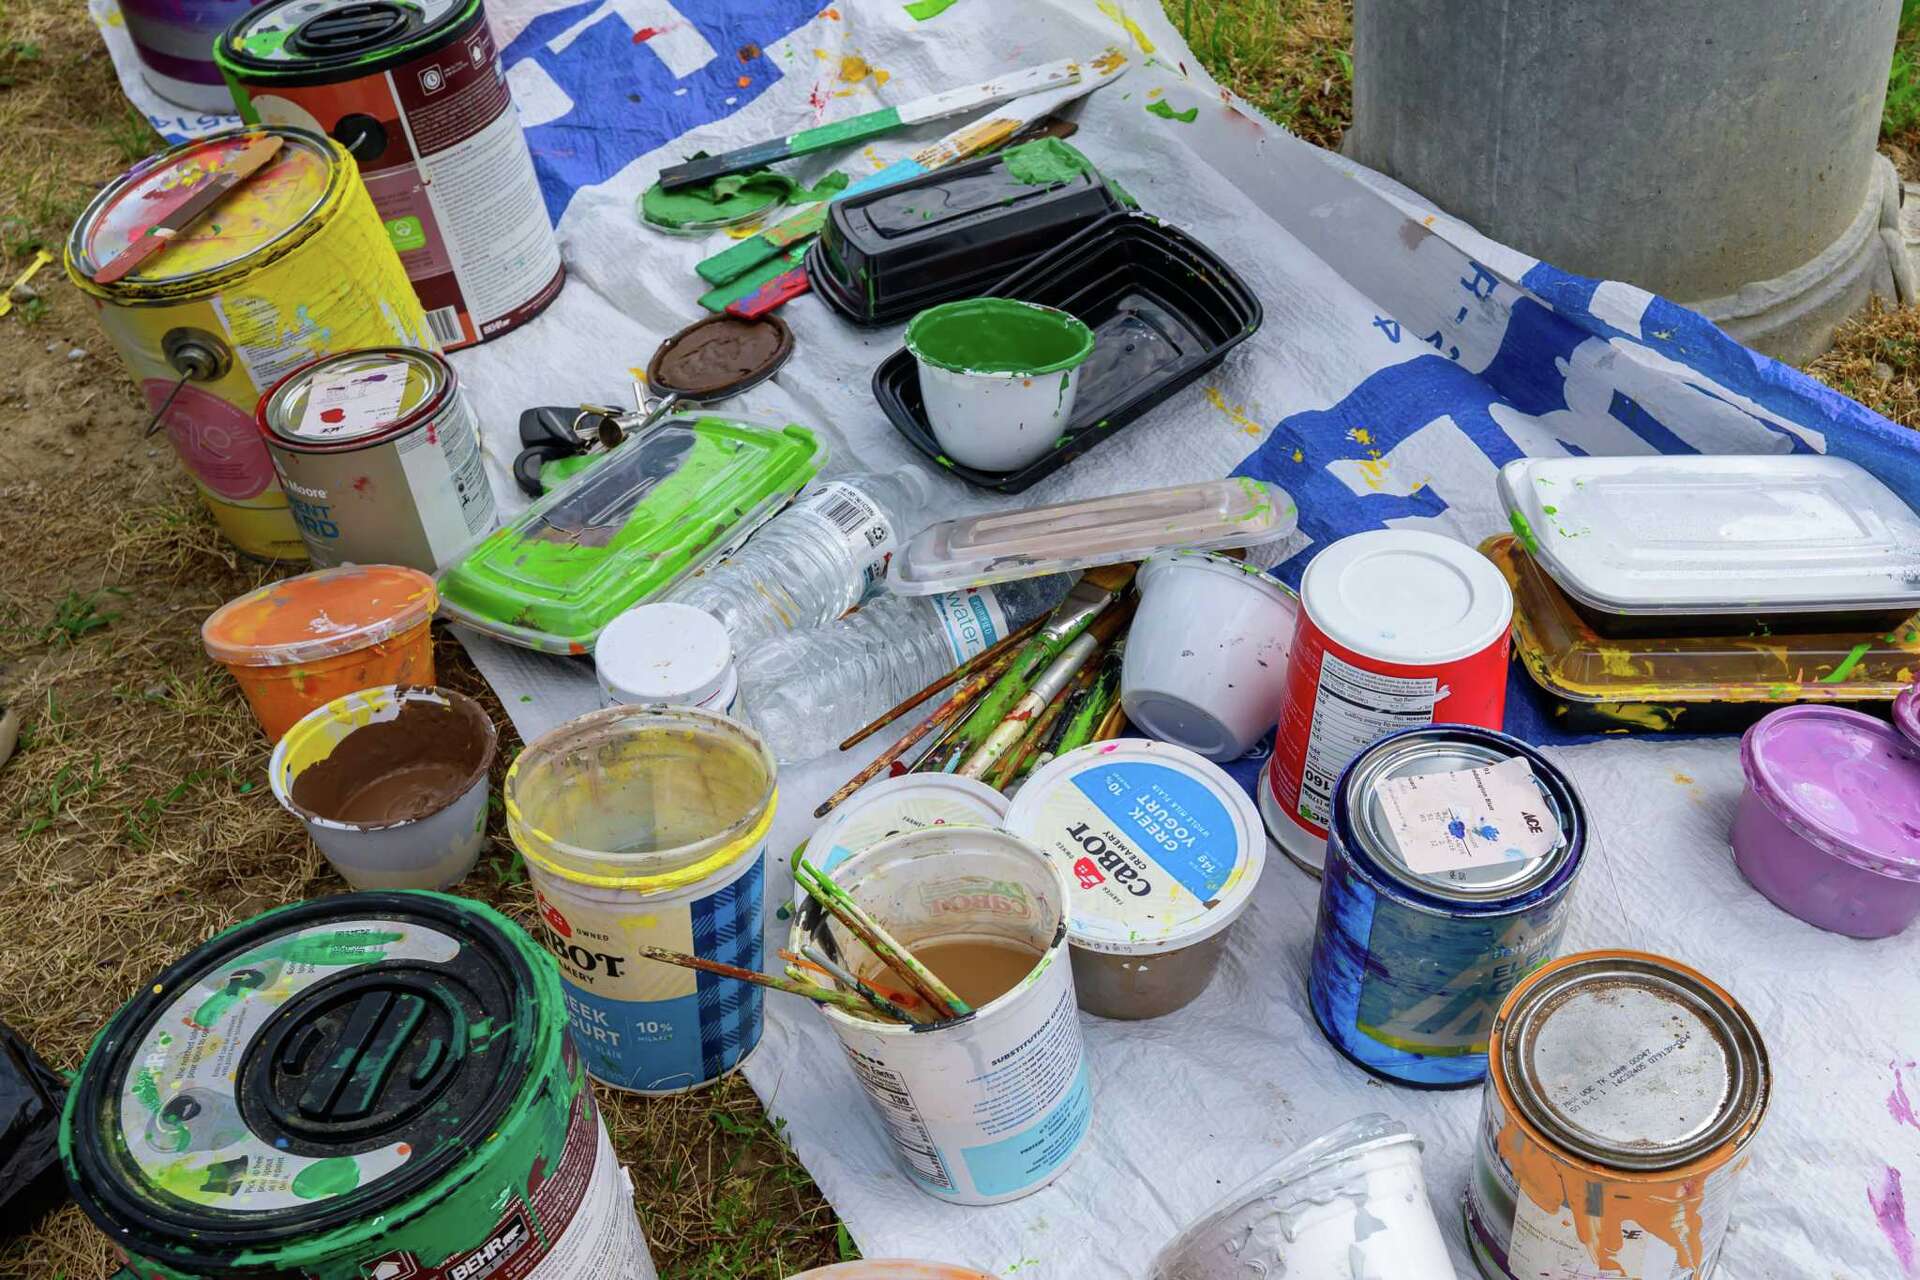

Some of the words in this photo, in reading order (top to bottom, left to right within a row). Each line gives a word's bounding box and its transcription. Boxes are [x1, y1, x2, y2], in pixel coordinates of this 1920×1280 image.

[946, 591, 980, 645] water
[1305, 770, 1331, 791] 160
[1128, 806, 1178, 851] GREEK
[1136, 795, 1195, 848] YOGURT
[1521, 811, 1543, 835] ACE
[1102, 829, 1147, 870] CREAMERY
[550, 928, 625, 978] BOT
[576, 928, 609, 942] OWNED
[564, 991, 609, 1027] EEK
[636, 1021, 673, 1034] 10%
[569, 1014, 621, 1047] GURT
[992, 1020, 1051, 1067] SUBSTITUTION
[450, 1236, 505, 1280] BEHR
